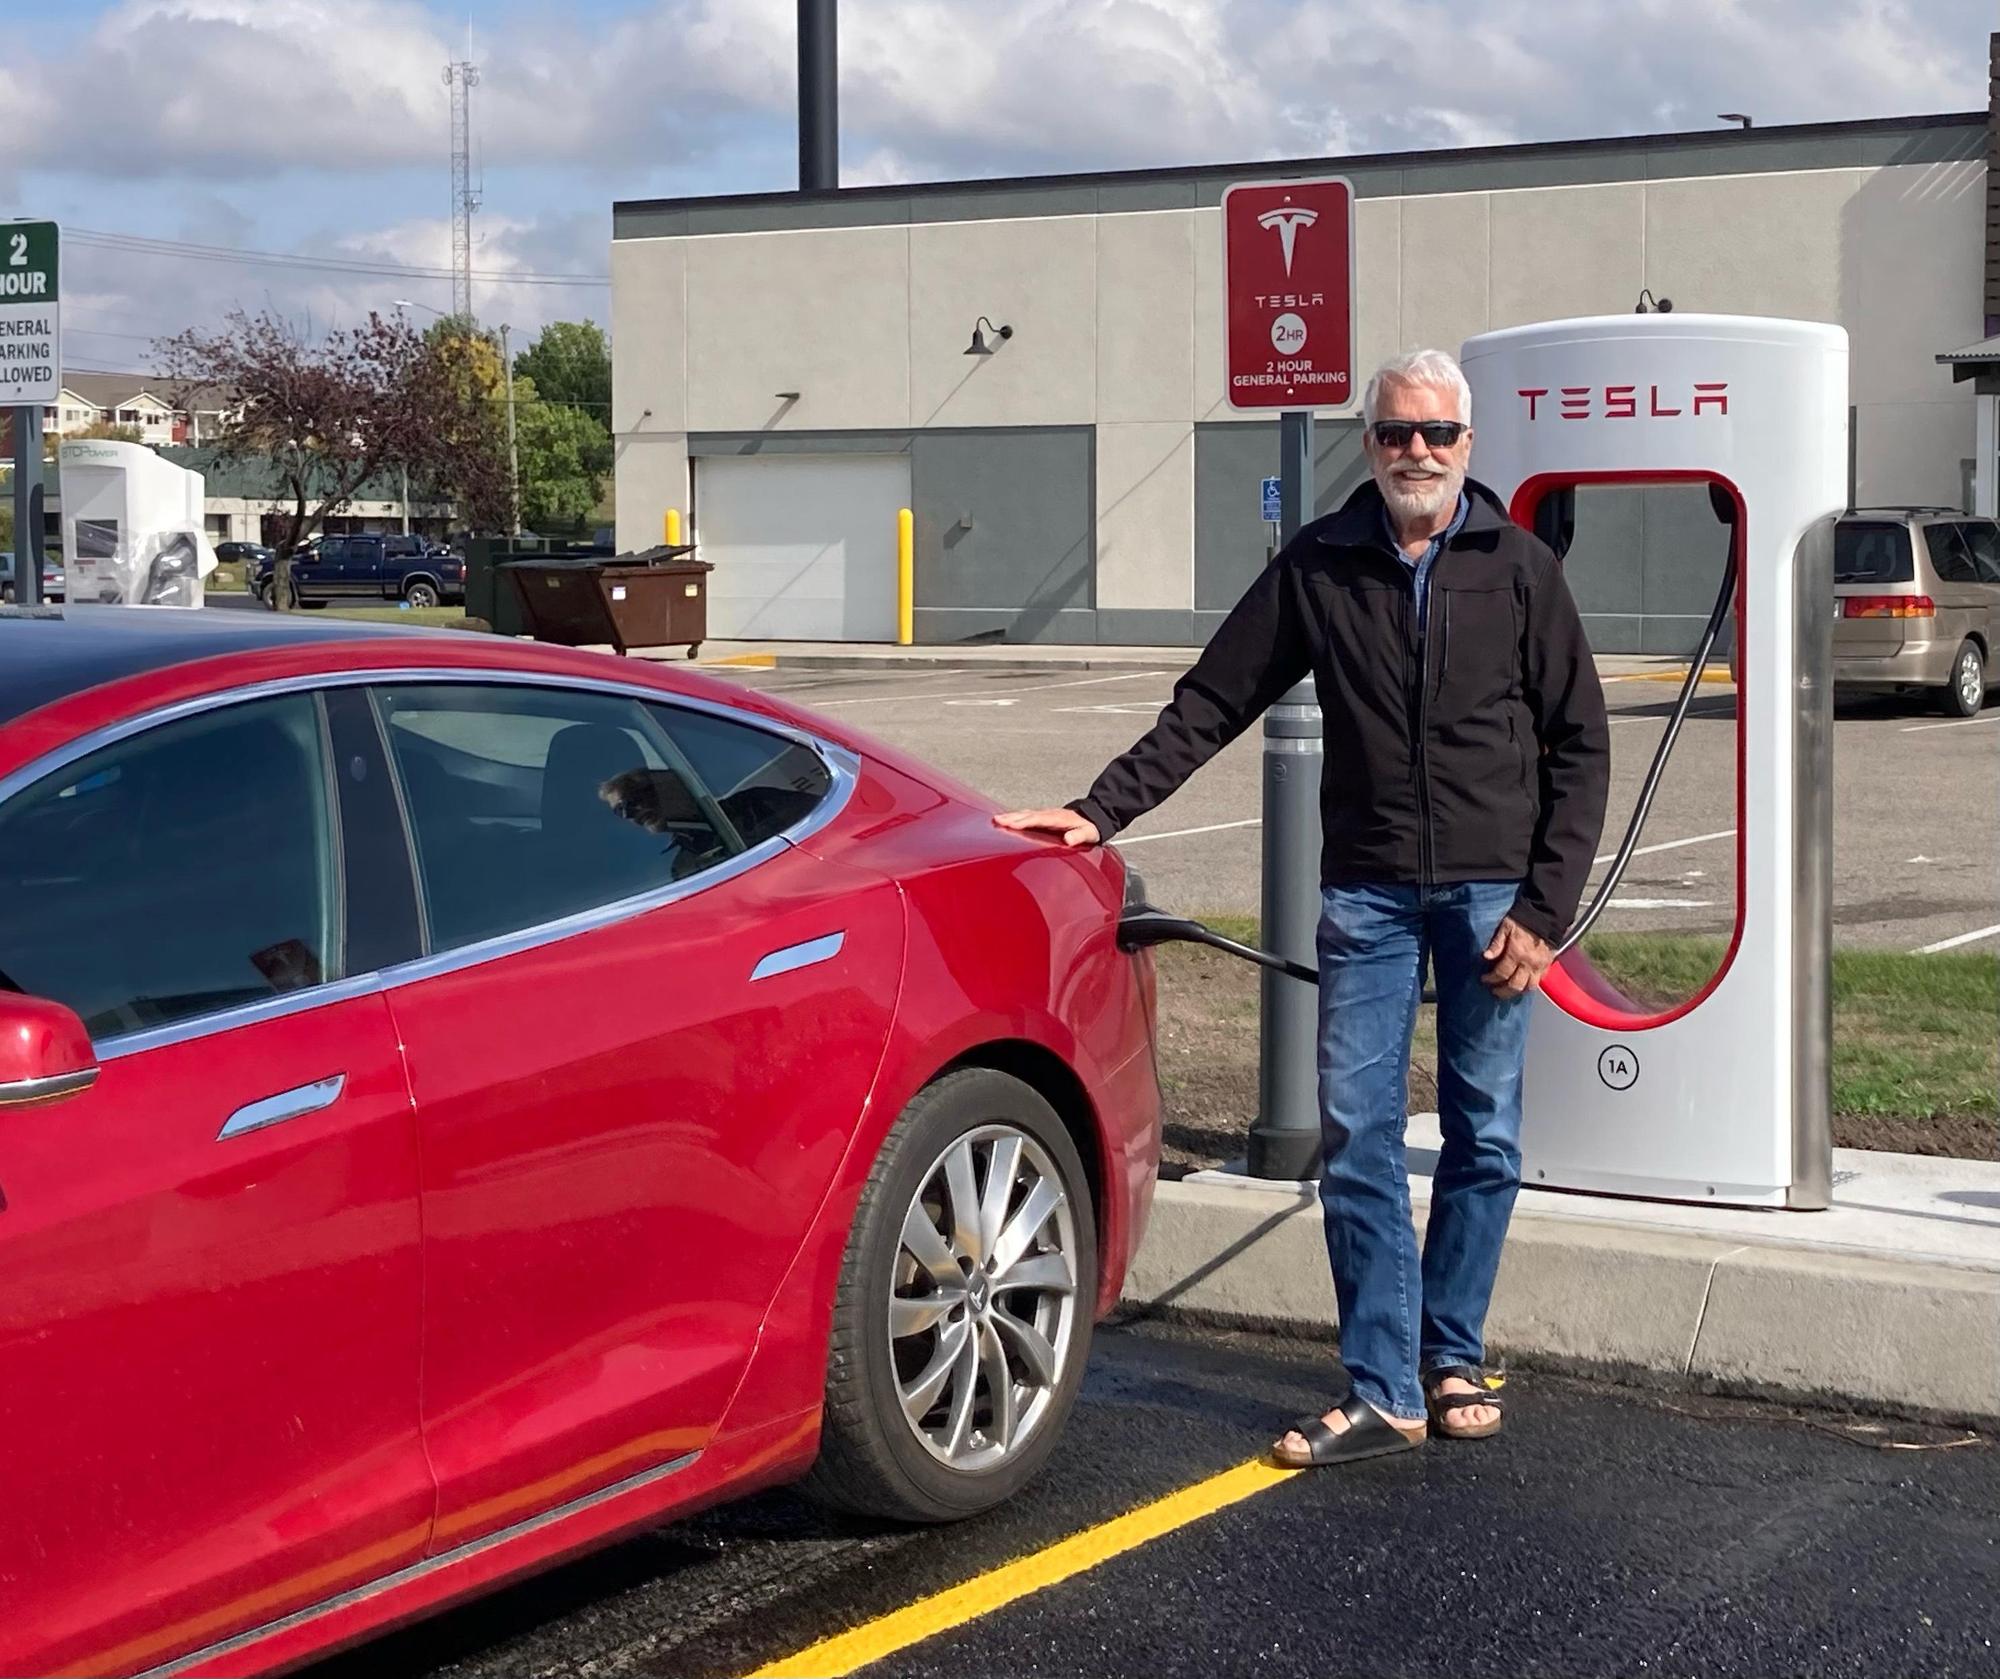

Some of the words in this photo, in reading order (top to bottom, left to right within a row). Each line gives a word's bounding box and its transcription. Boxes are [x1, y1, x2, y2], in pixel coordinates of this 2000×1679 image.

[10, 233, 28, 266] 2
[1255, 293, 1324, 309] TESLA
[1276, 325, 1304, 342] 2HR
[1266, 361, 1274, 373] 2
[1277, 360, 1313, 372] HOUR
[1233, 374, 1291, 387] GENERAL
[1293, 371, 1347, 385] PARKING
[1518, 383, 1728, 421] TESLA
[1608, 1059, 1628, 1075] 1A
